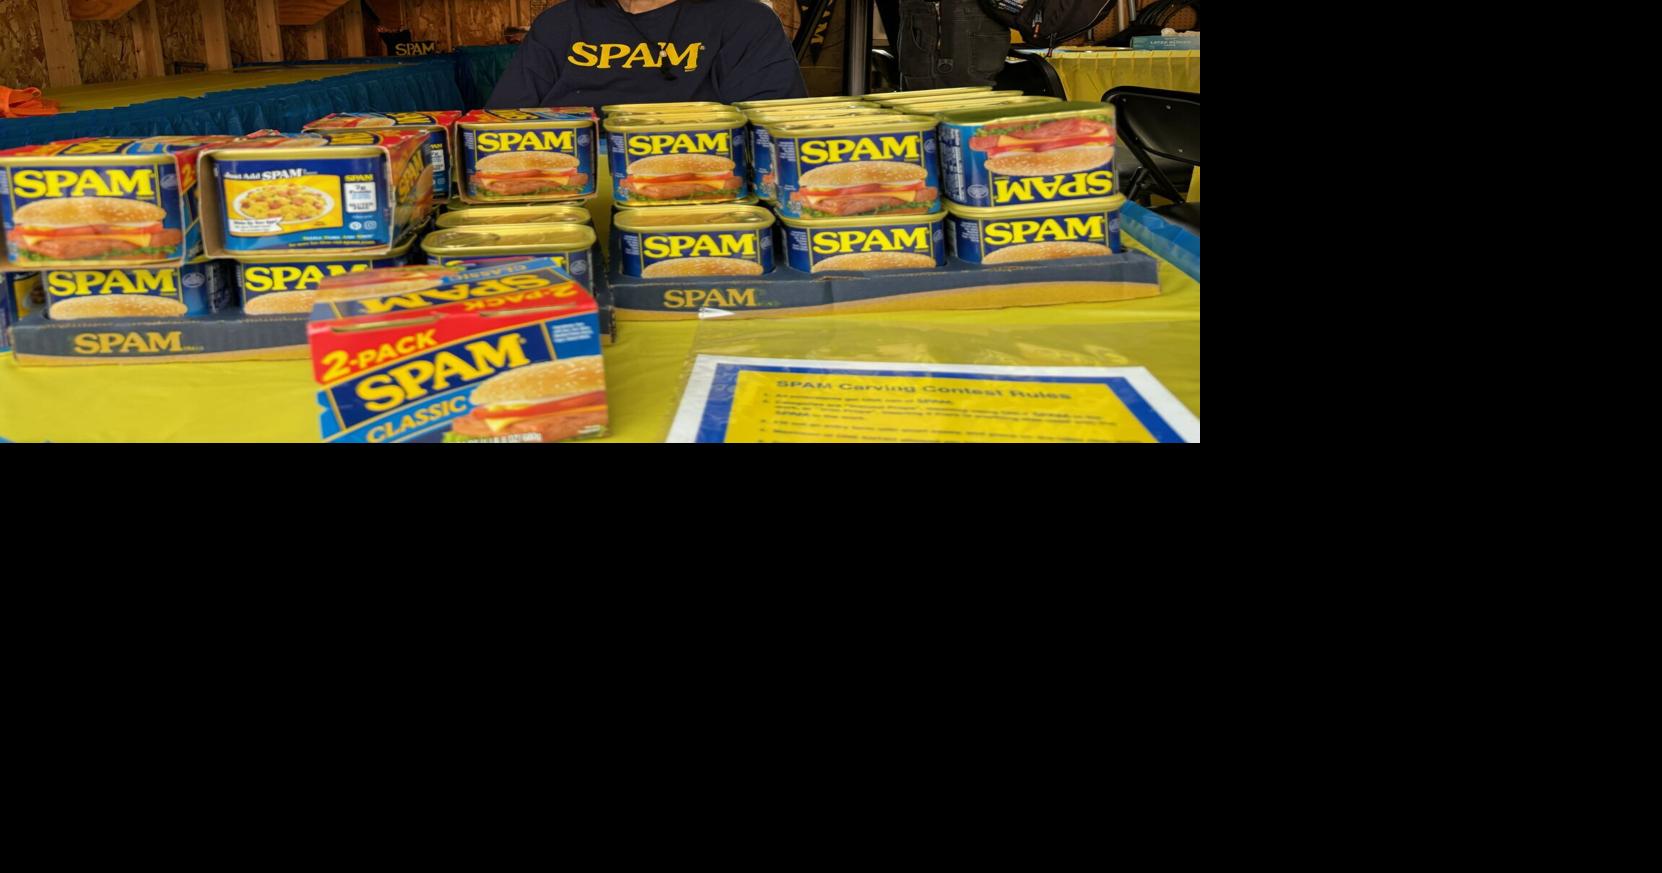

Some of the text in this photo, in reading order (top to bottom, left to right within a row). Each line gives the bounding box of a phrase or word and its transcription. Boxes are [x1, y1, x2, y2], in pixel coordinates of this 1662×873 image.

[395, 43, 434, 56] SPAM
[568, 41, 702, 70] SPAM
[477, 131, 575, 152] SPAM
[628, 133, 730, 156] SPAM
[800, 135, 921, 164] SPAM
[14, 169, 155, 198] SPAM
[262, 168, 305, 180] SPAM
[344, 174, 374, 182] SPAM
[994, 170, 1114, 204] SPAM
[813, 228, 930, 255] SPAM
[984, 216, 1105, 246] SPAM
[643, 233, 756, 259] SPAM
[48, 269, 177, 296] SPAM
[360, 274, 551, 315] SPAM
[463, 283, 579, 312] 2-PACK
[664, 288, 756, 309] SPAM
[75, 332, 182, 355] SPAM
[321, 328, 440, 382] 2-PACK
[356, 332, 531, 412] SPAM
[776, 380, 1072, 400] SPAM Carving Contest Rules
[366, 394, 469, 443] CLASSIC
